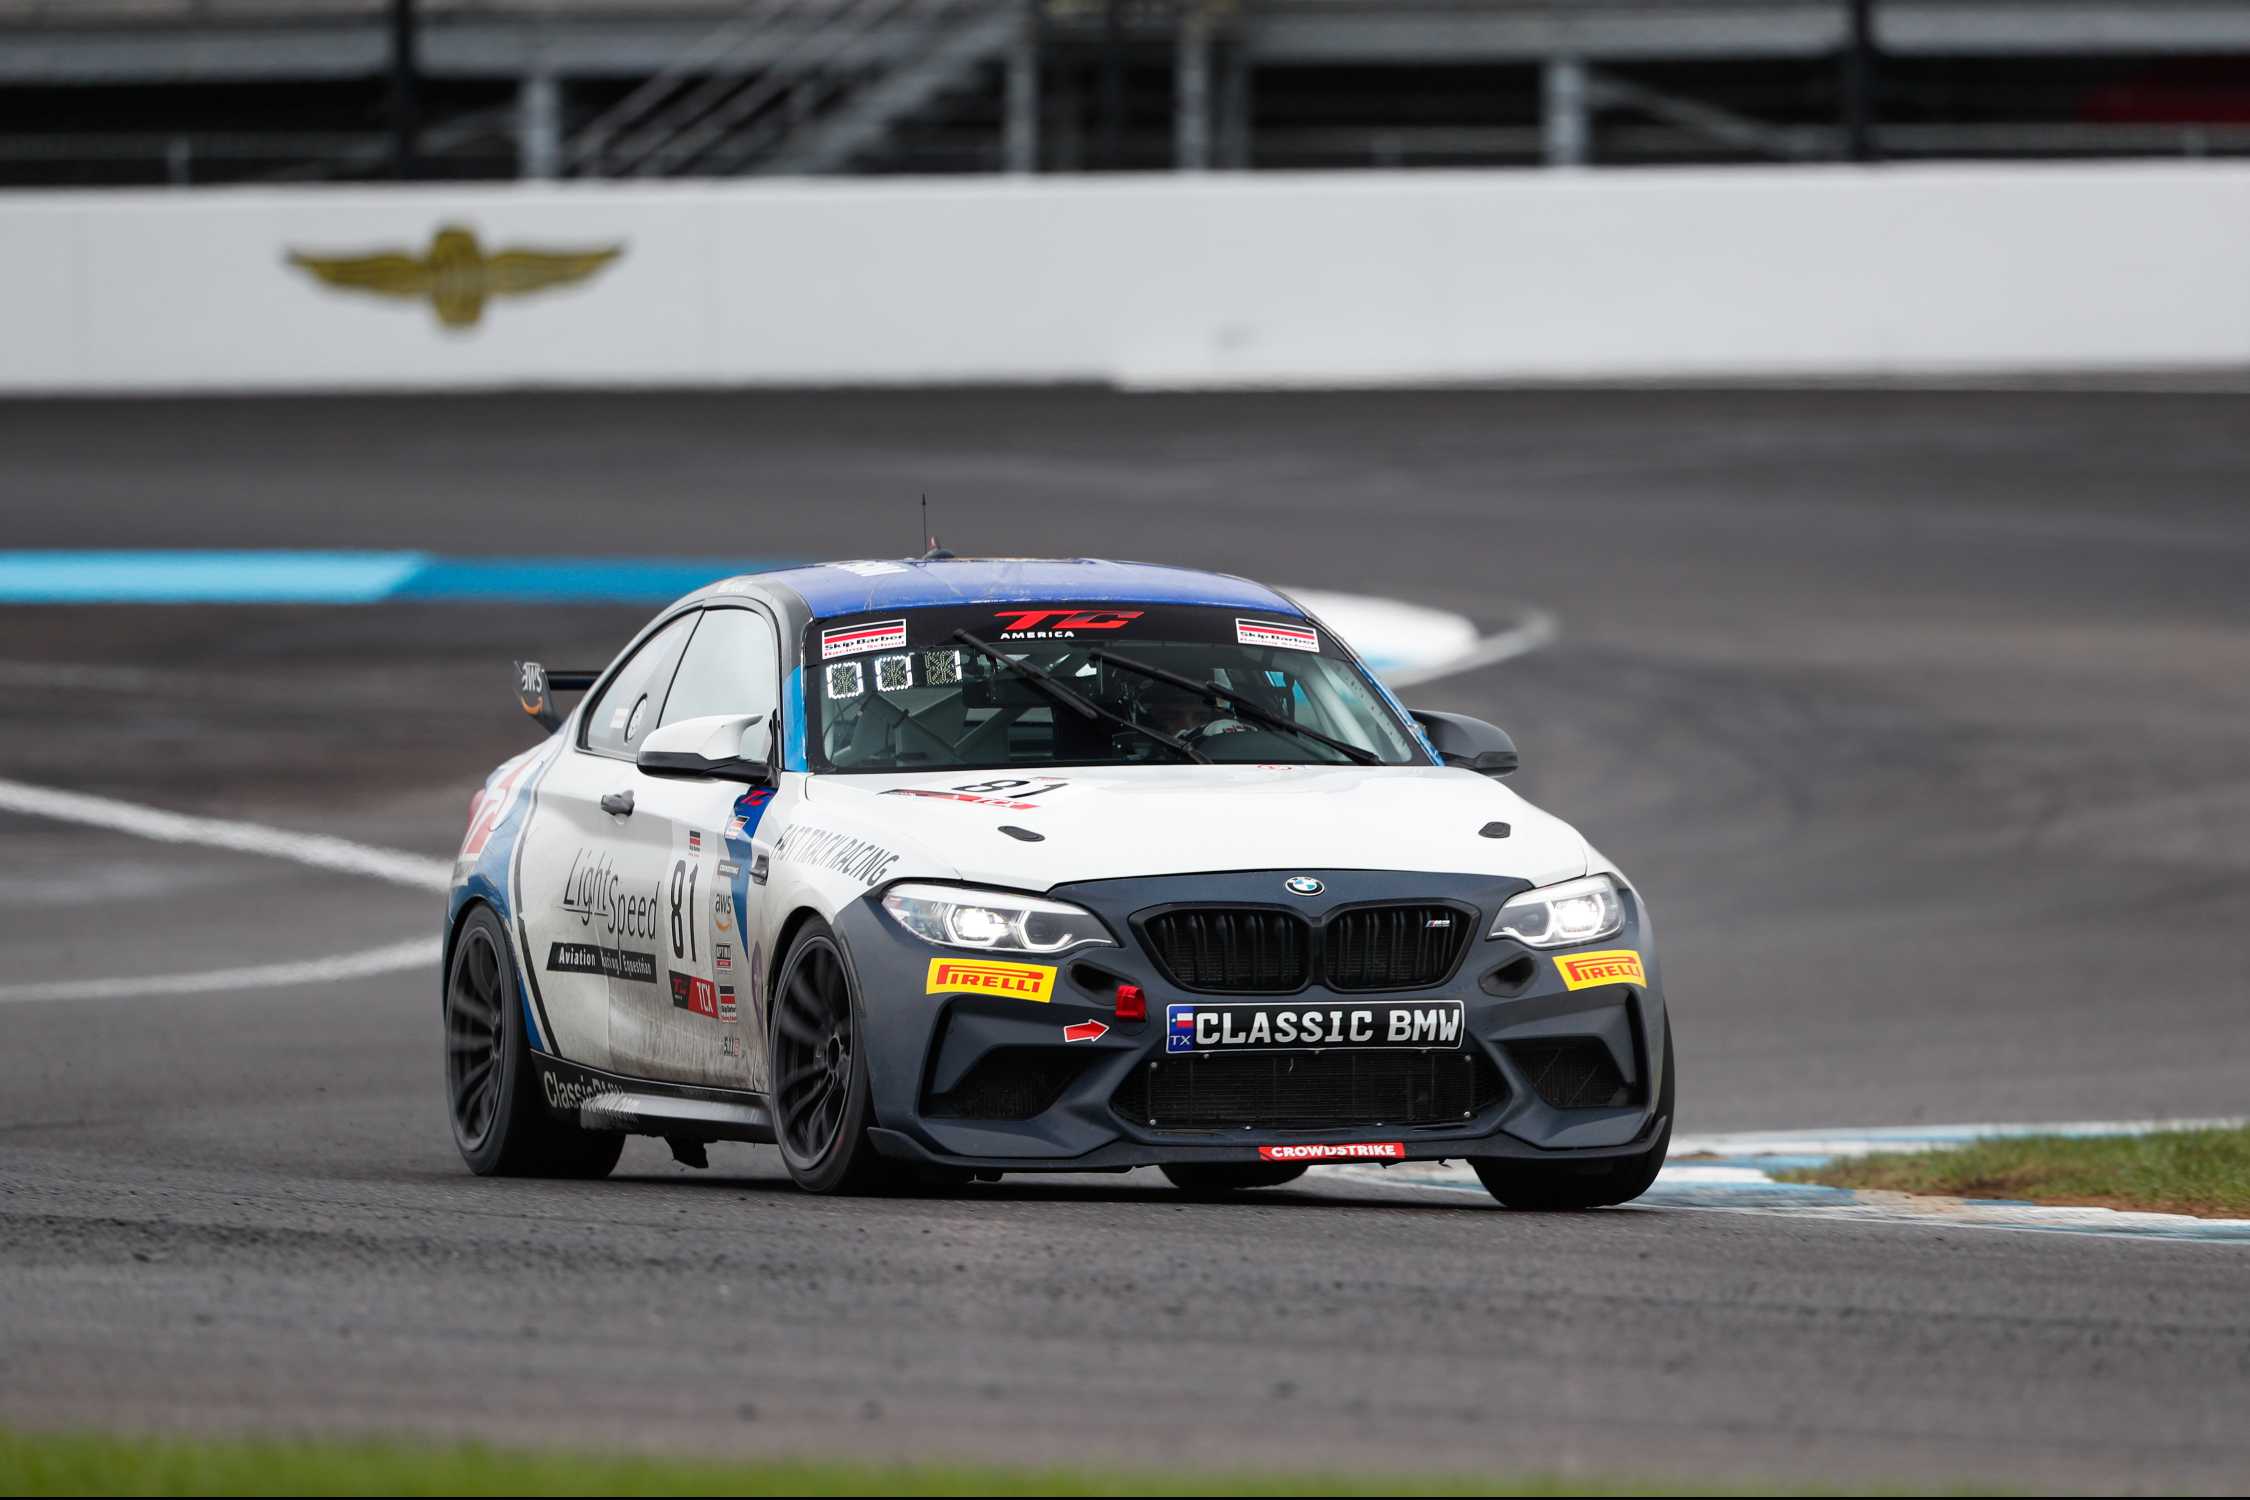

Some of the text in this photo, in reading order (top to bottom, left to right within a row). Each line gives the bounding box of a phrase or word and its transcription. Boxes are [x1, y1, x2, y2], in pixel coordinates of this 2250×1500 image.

[994, 609, 1145, 630] TC
[825, 634, 904, 651] Skip Barber
[1000, 630, 1075, 640] AMERICA
[1240, 631, 1316, 645] Skip Barber
[521, 662, 543, 694] aws
[825, 838, 900, 887] RACING
[670, 859, 699, 963] 81
[715, 895, 732, 915] aws
[558, 946, 597, 967] Aviation
[936, 964, 1044, 993] PIRELLI
[1565, 956, 1641, 982] PIRELLI
[697, 980, 715, 1014] TCX
[1195, 1008, 1460, 1045] CLASSIC BMW
[1170, 1035, 1192, 1046] TX
[1271, 1145, 1396, 1158] CROWDSTRIKE
